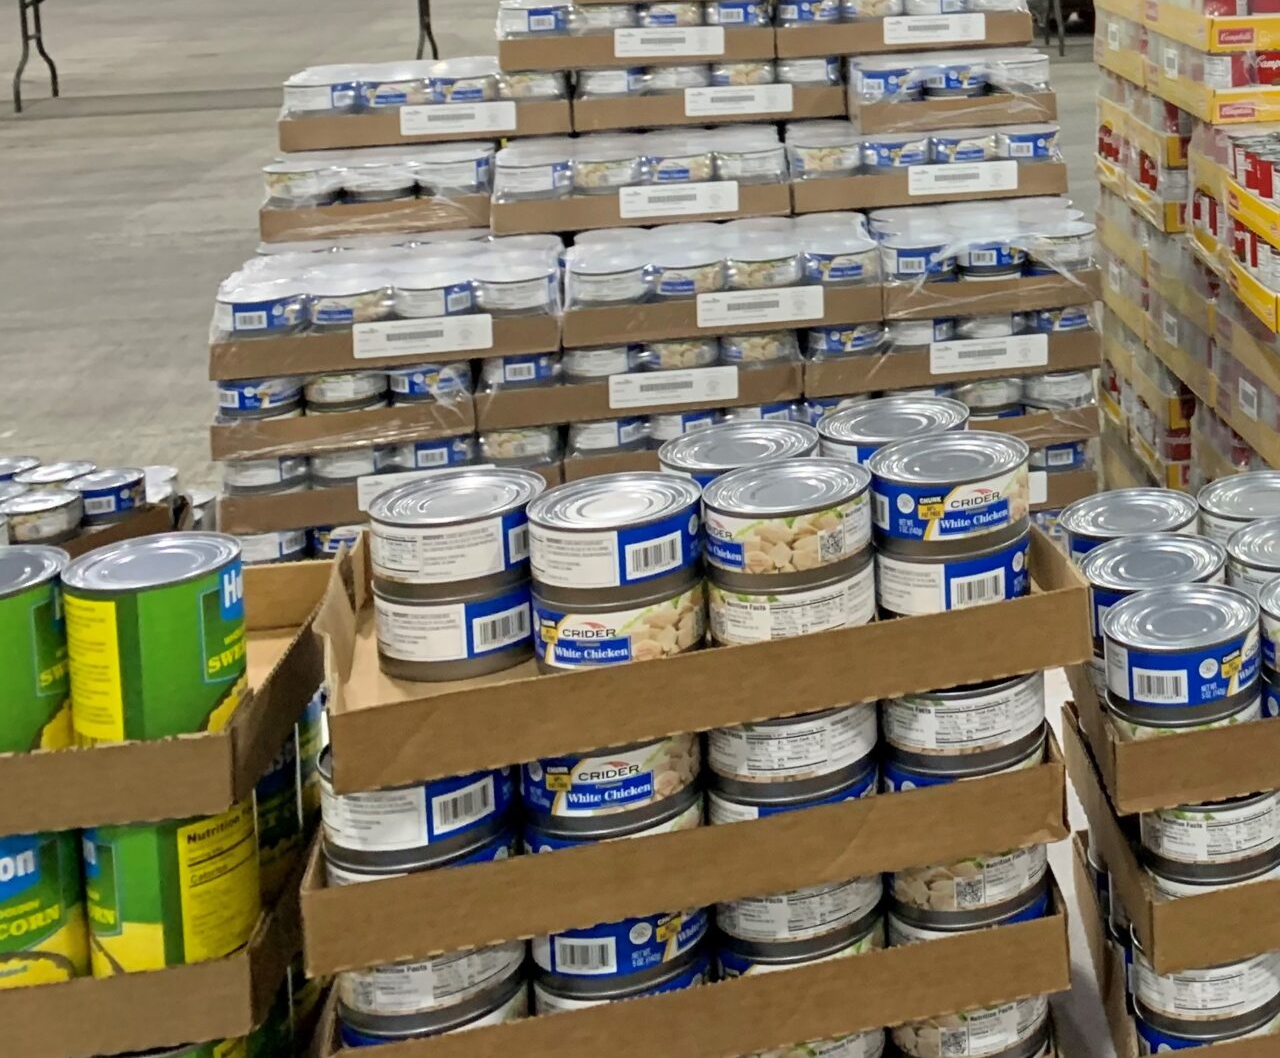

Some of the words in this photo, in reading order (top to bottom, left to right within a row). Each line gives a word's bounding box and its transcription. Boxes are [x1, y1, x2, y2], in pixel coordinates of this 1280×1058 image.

[951, 491, 1000, 509] CRIDER
[940, 518, 971, 529] White
[973, 509, 1008, 525] Chicken
[708, 526, 733, 539] RIDER
[713, 543, 742, 560] Chicken
[562, 628, 616, 639] CRIDER
[555, 645, 583, 658] White
[584, 647, 628, 660] Chicken
[578, 764, 640, 782] CRIDER
[568, 791, 602, 804] White
[604, 784, 651, 802] Chicken
[187, 815, 240, 844] Nutrition
